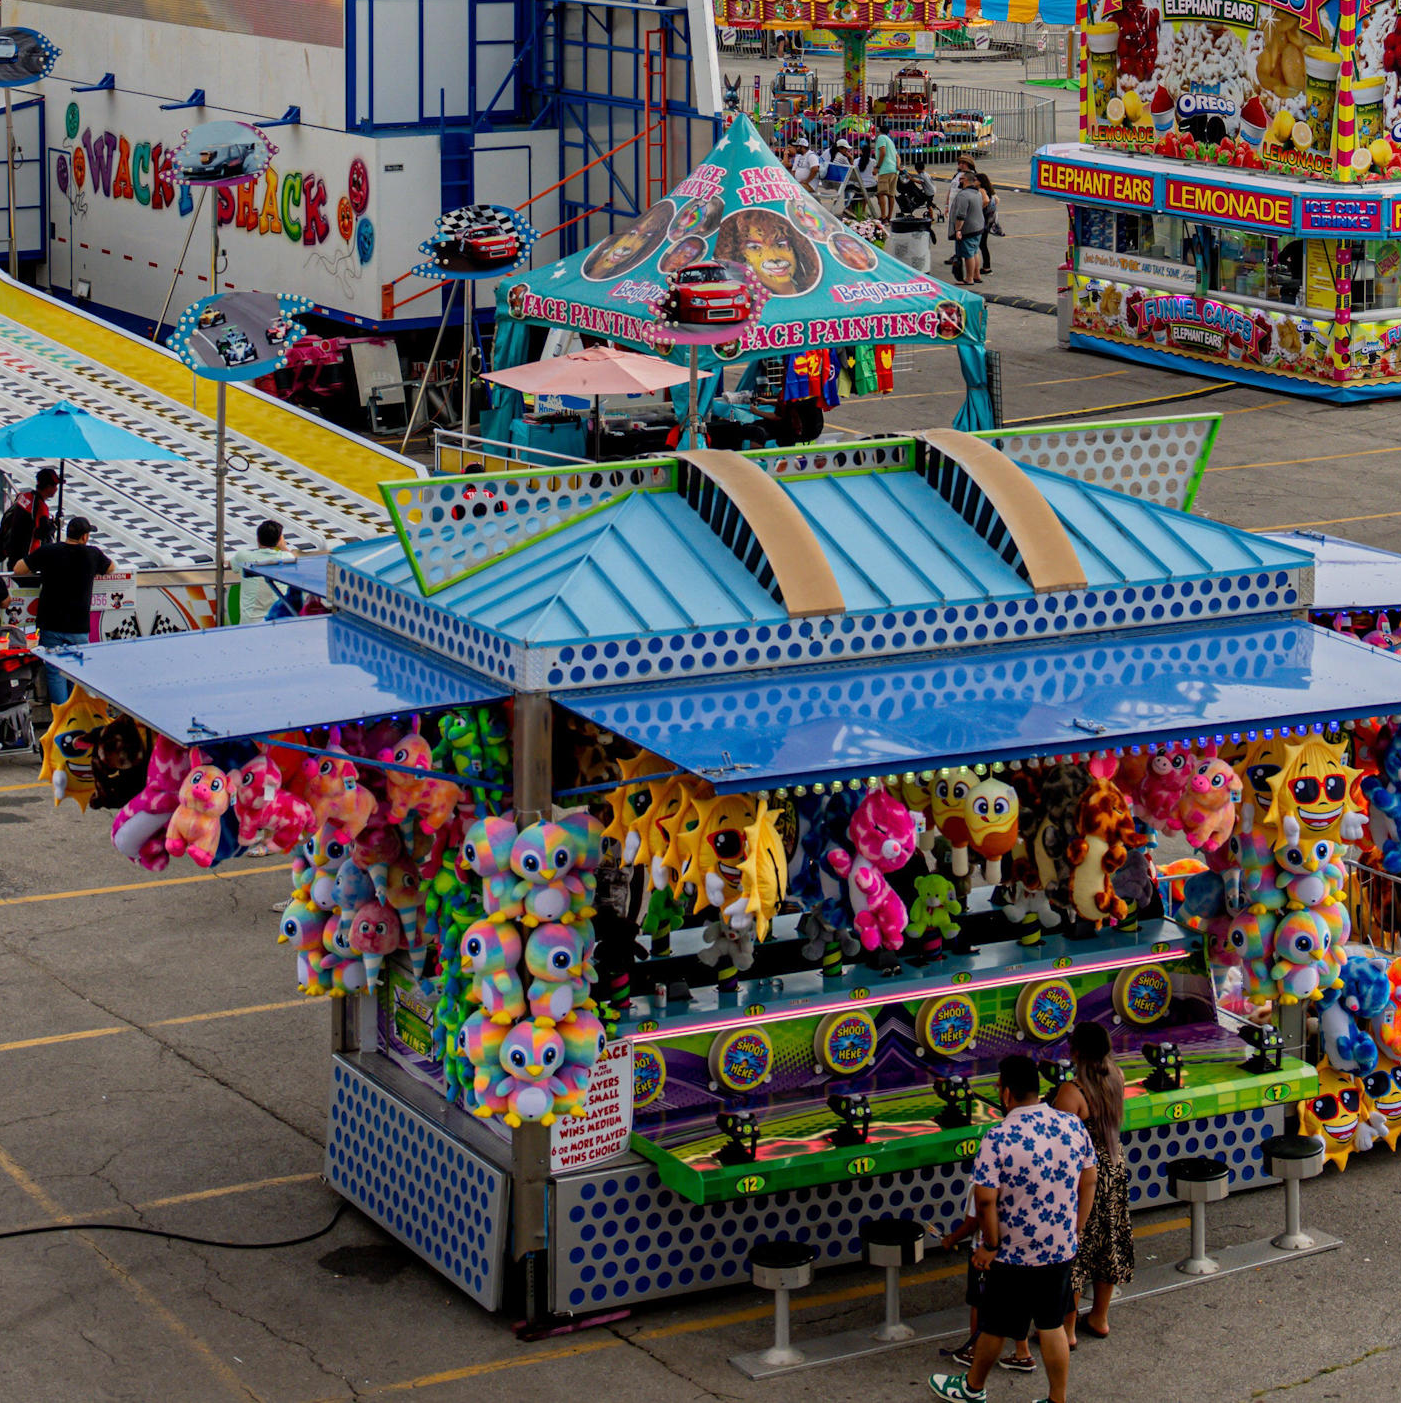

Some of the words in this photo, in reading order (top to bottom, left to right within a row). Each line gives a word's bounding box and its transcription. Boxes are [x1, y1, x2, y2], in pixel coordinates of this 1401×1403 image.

[1223, 3, 1255, 23] EARS
[1190, 81, 1220, 94] Fried
[1177, 95, 1236, 116] OREOS
[1091, 125, 1154, 143] LEMONADE
[1263, 142, 1333, 175] LEMONADE
[740, 166, 789, 186] FACE
[1041, 164, 1112, 197] ELEPHANT
[1114, 180, 1152, 203] EARS
[670, 180, 724, 201] PAINT
[737, 183, 802, 205] PAINT
[1169, 187, 1290, 226] LEMONADE
[1305, 200, 1331, 213] ICE
[1335, 200, 1377, 215] COLD
[1310, 215, 1371, 230] DRINKS
[1142, 263, 1151, 273] AND
[1152, 265, 1165, 277] TAKE
[1166, 267, 1180, 278] SOME
[617, 280, 643, 302] Body
[838, 283, 879, 304] Body
[877, 280, 936, 297] Pizzazz
[522, 293, 568, 322] FACE
[1144, 299, 1201, 323] FUNNEL
[1203, 302, 1254, 342] CAKES
[740, 321, 805, 353] FACE
[808, 311, 940, 345] PAINTING
[1173, 327, 1203, 345] ELEPHANT
[1204, 332, 1223, 349] EARS
[1138, 975, 1165, 991] SHOOT
[854, 989, 866, 999] 10
[1046, 989, 1070, 1012] SHOOT
[749, 1005, 761, 1016] 11
[938, 1007, 965, 1021] SHOOT
[643, 1021, 653, 1033] 12
[837, 1025, 866, 1037] SHOOT
[401, 1028, 427, 1057] WINS
[737, 1041, 765, 1057] SHOOT
[589, 1089, 620, 1106] SMALL
[1274, 1084, 1282, 1100] 7
[579, 1103, 620, 1123] PLAYERS
[1173, 1104, 1182, 1119] 8
[559, 1125, 586, 1139] WINS
[587, 1115, 622, 1133] MEDIUM
[551, 1146, 557, 1156] 6
[558, 1146, 568, 1155] OR
[570, 1138, 594, 1152] MORE
[596, 1126, 628, 1147] PLAYERS
[962, 1141, 977, 1157] 10
[561, 1152, 587, 1166] WINS
[588, 1141, 621, 1160] CHOICE
[854, 1158, 869, 1174] 11
[743, 1175, 758, 1194] 12
